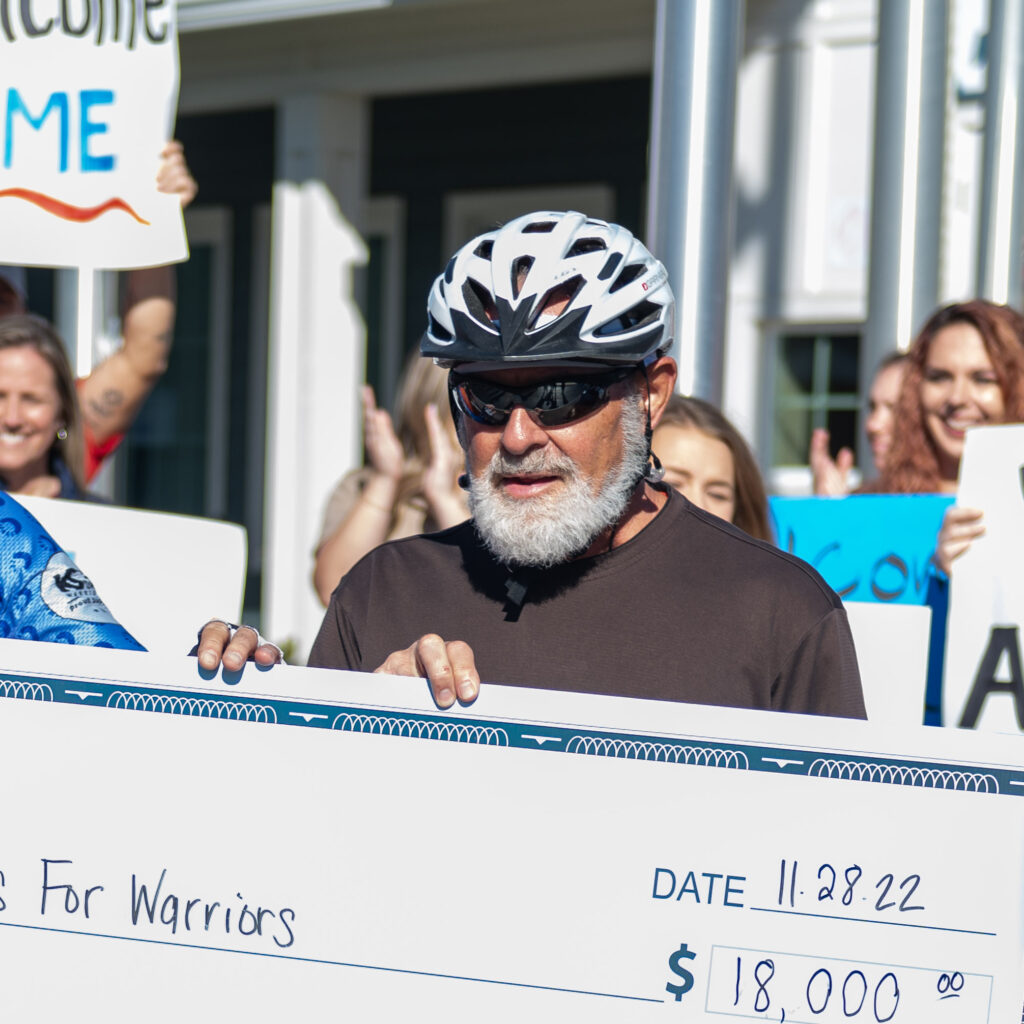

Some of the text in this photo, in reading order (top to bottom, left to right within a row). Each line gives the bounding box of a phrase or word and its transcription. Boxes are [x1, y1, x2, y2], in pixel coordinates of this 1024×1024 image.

[41, 858, 105, 919] For
[131, 868, 296, 948] Warriors
[652, 867, 747, 908] DATE
[733, 956, 900, 1024] 18,000
